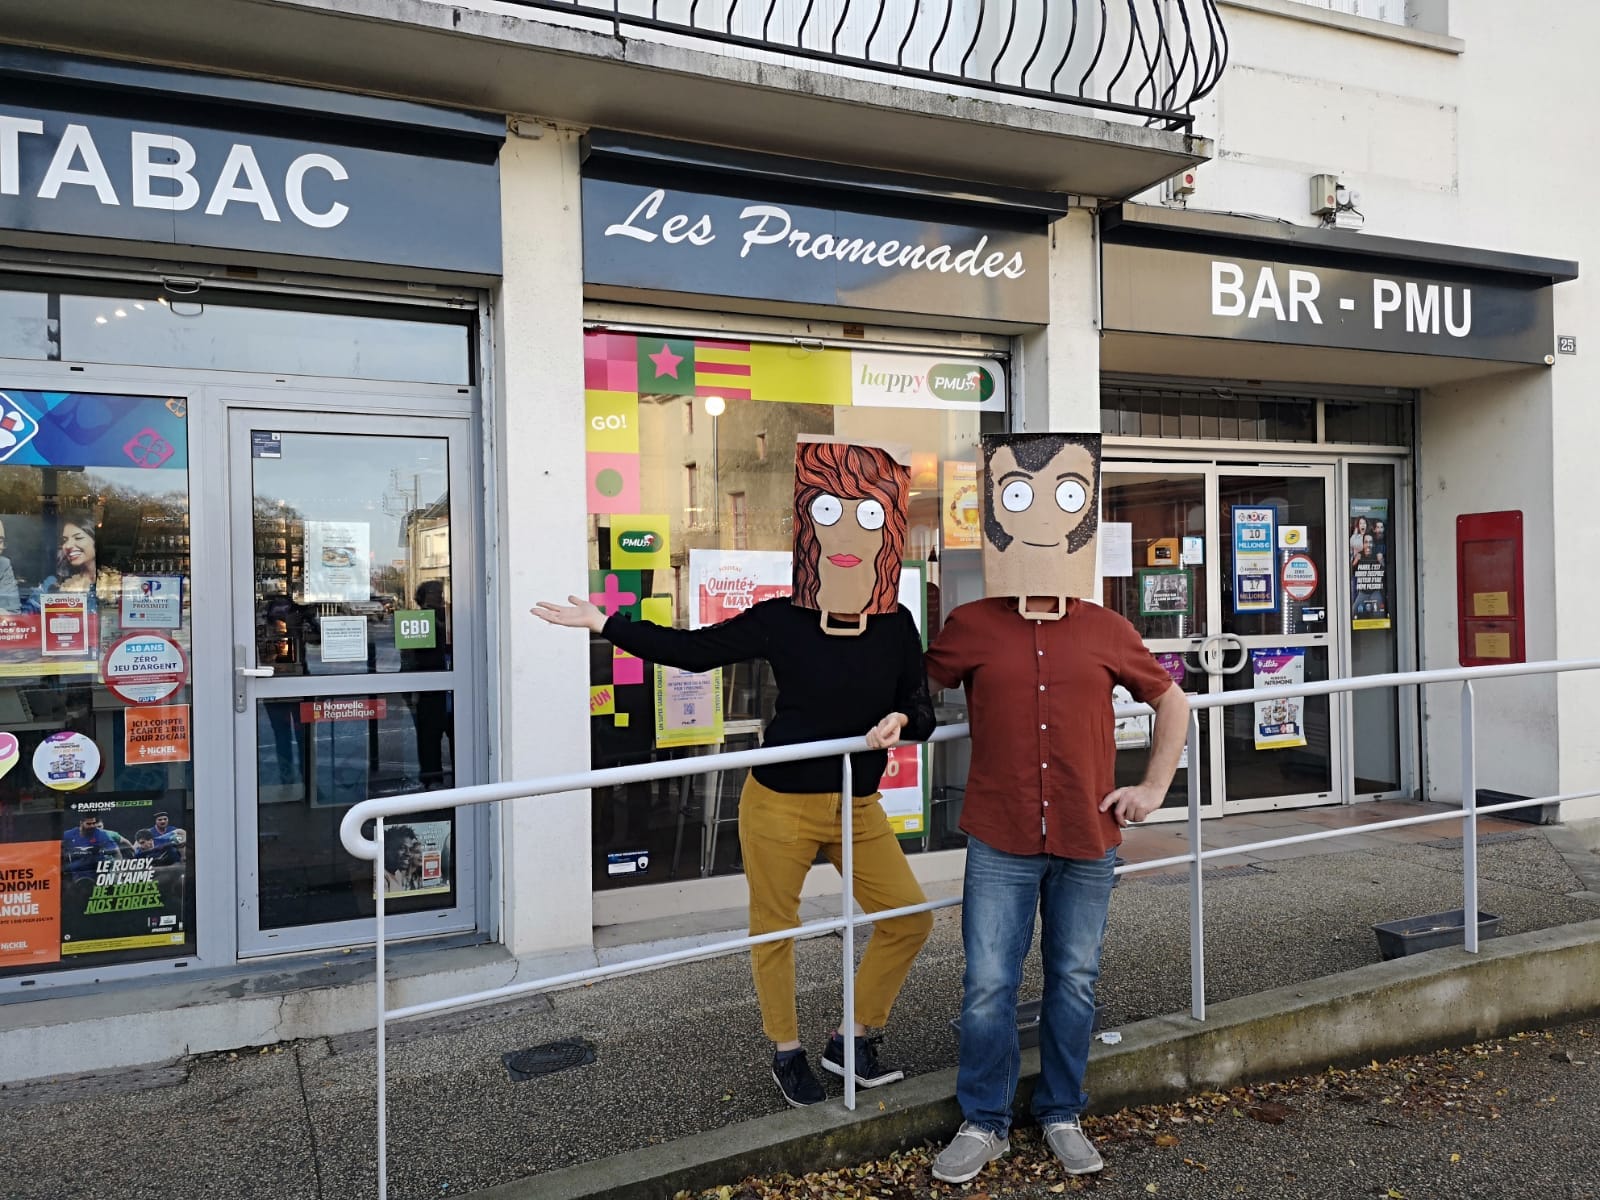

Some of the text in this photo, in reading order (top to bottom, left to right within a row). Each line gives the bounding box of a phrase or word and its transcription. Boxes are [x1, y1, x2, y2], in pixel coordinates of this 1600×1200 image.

[0, 115, 349, 228] TABAC
[605, 189, 1025, 279] Les Promenades
[1211, 261, 1323, 324] BAR
[1373, 279, 1471, 337] PMU
[1560, 338, 1574, 352] 25
[861, 364, 966, 393] happy PMU
[591, 414, 627, 430] GO!
[1250, 529, 1261, 539] 10
[622, 538, 646, 547] PMU
[707, 577, 755, 593] Quinté+
[55, 596, 80, 607] amigo
[725, 596, 751, 606] MAX
[400, 619, 430, 636] CBD
[133, 655, 158, 663] ZÉRO
[114, 663, 178, 672] JEU D'ARGENT
[313, 701, 364, 711] la Nouvelle
[590, 689, 612, 711] FUN
[323, 708, 375, 719] République
[132, 720, 143, 728] ICI
[150, 718, 183, 727] COMPTE
[130, 734, 153, 742] POUR
[136, 727, 163, 735] CARTE
[78, 801, 116, 810] PARIONS
[96, 857, 154, 873] LE RUGBY,
[96, 870, 156, 886] ON L'AIME
[91, 880, 159, 898] DE TOUTES
[86, 898, 112, 914] NOS
